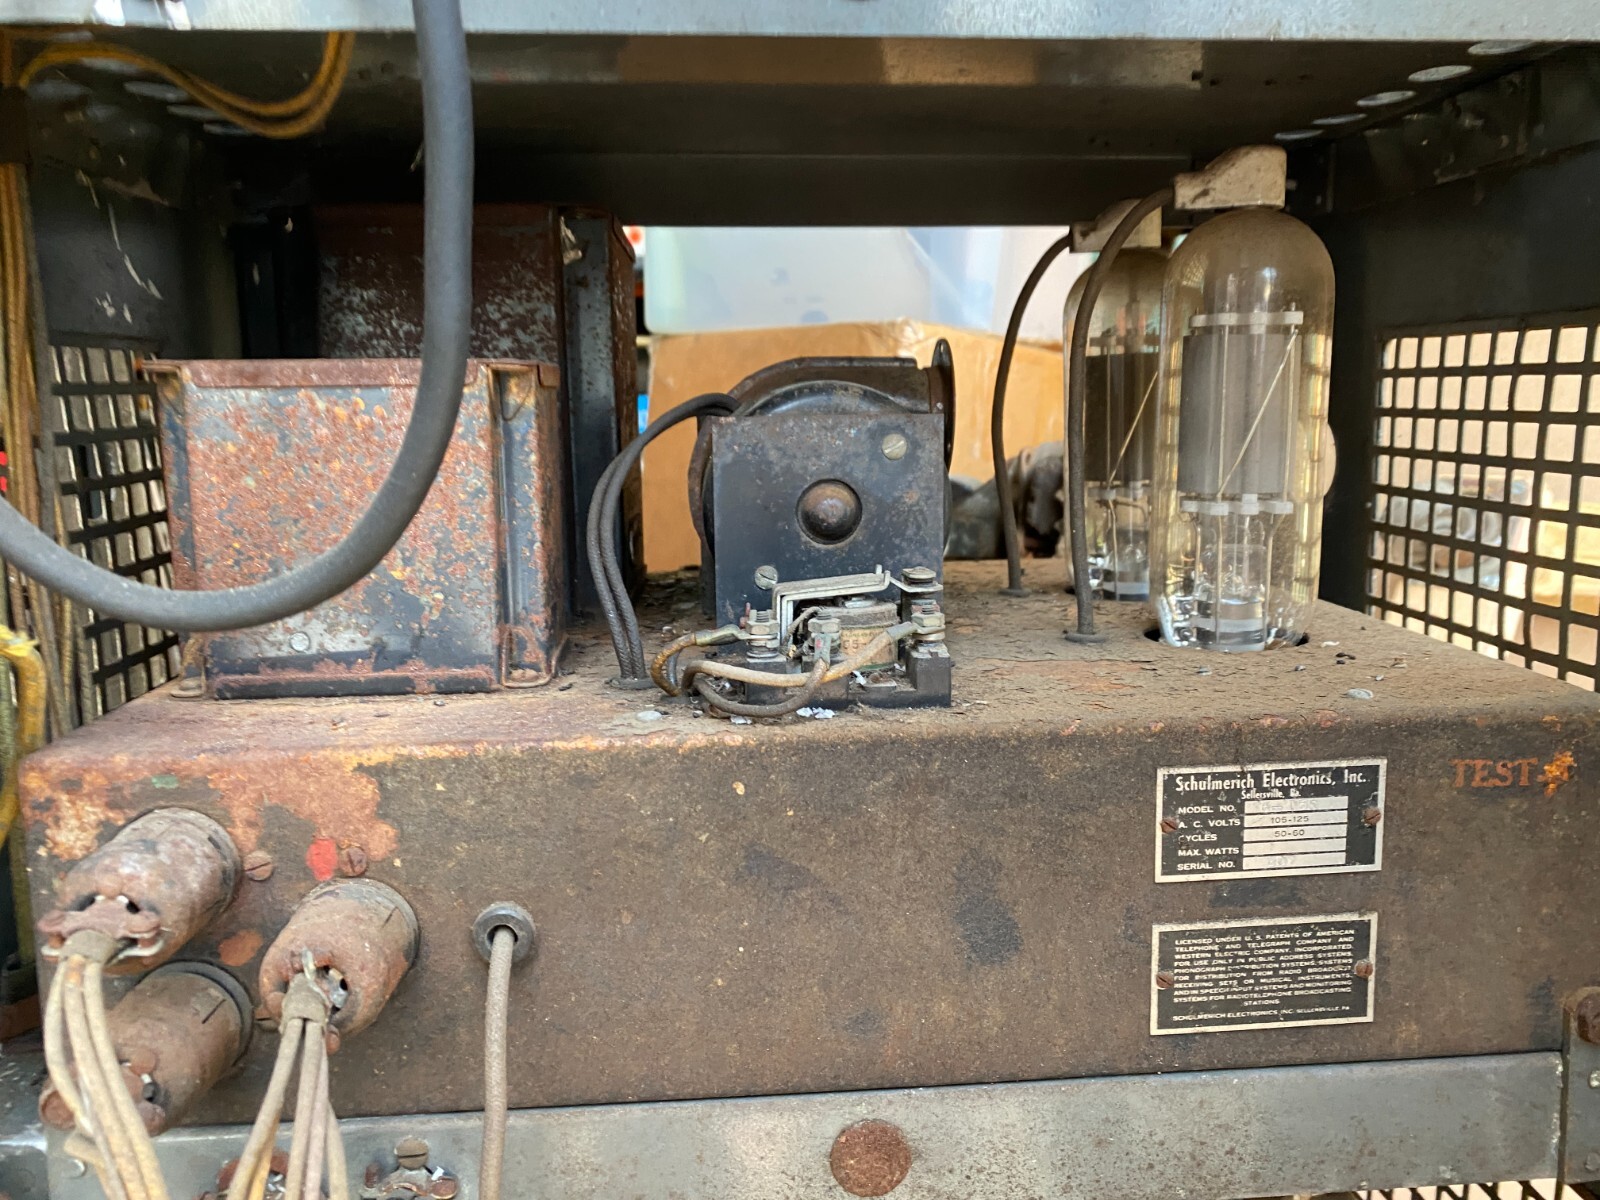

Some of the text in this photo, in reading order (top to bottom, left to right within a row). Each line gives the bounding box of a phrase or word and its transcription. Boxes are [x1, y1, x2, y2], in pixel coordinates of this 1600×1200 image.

[1175, 769, 1366, 791] Schulmerich Electronics, Inc.
[1241, 788, 1285, 799] Sellersville,
[1178, 806, 1214, 814] MODEL
[1208, 819, 1240, 827] VOLTS
[1178, 829, 1305, 842] CYCLES 50-60
[1177, 863, 1212, 871] SERIAL
[1266, 932, 1299, 940] PATENTS
[1248, 940, 1291, 948] TELEGRAPH
[1280, 953, 1314, 961] ADDRESS
